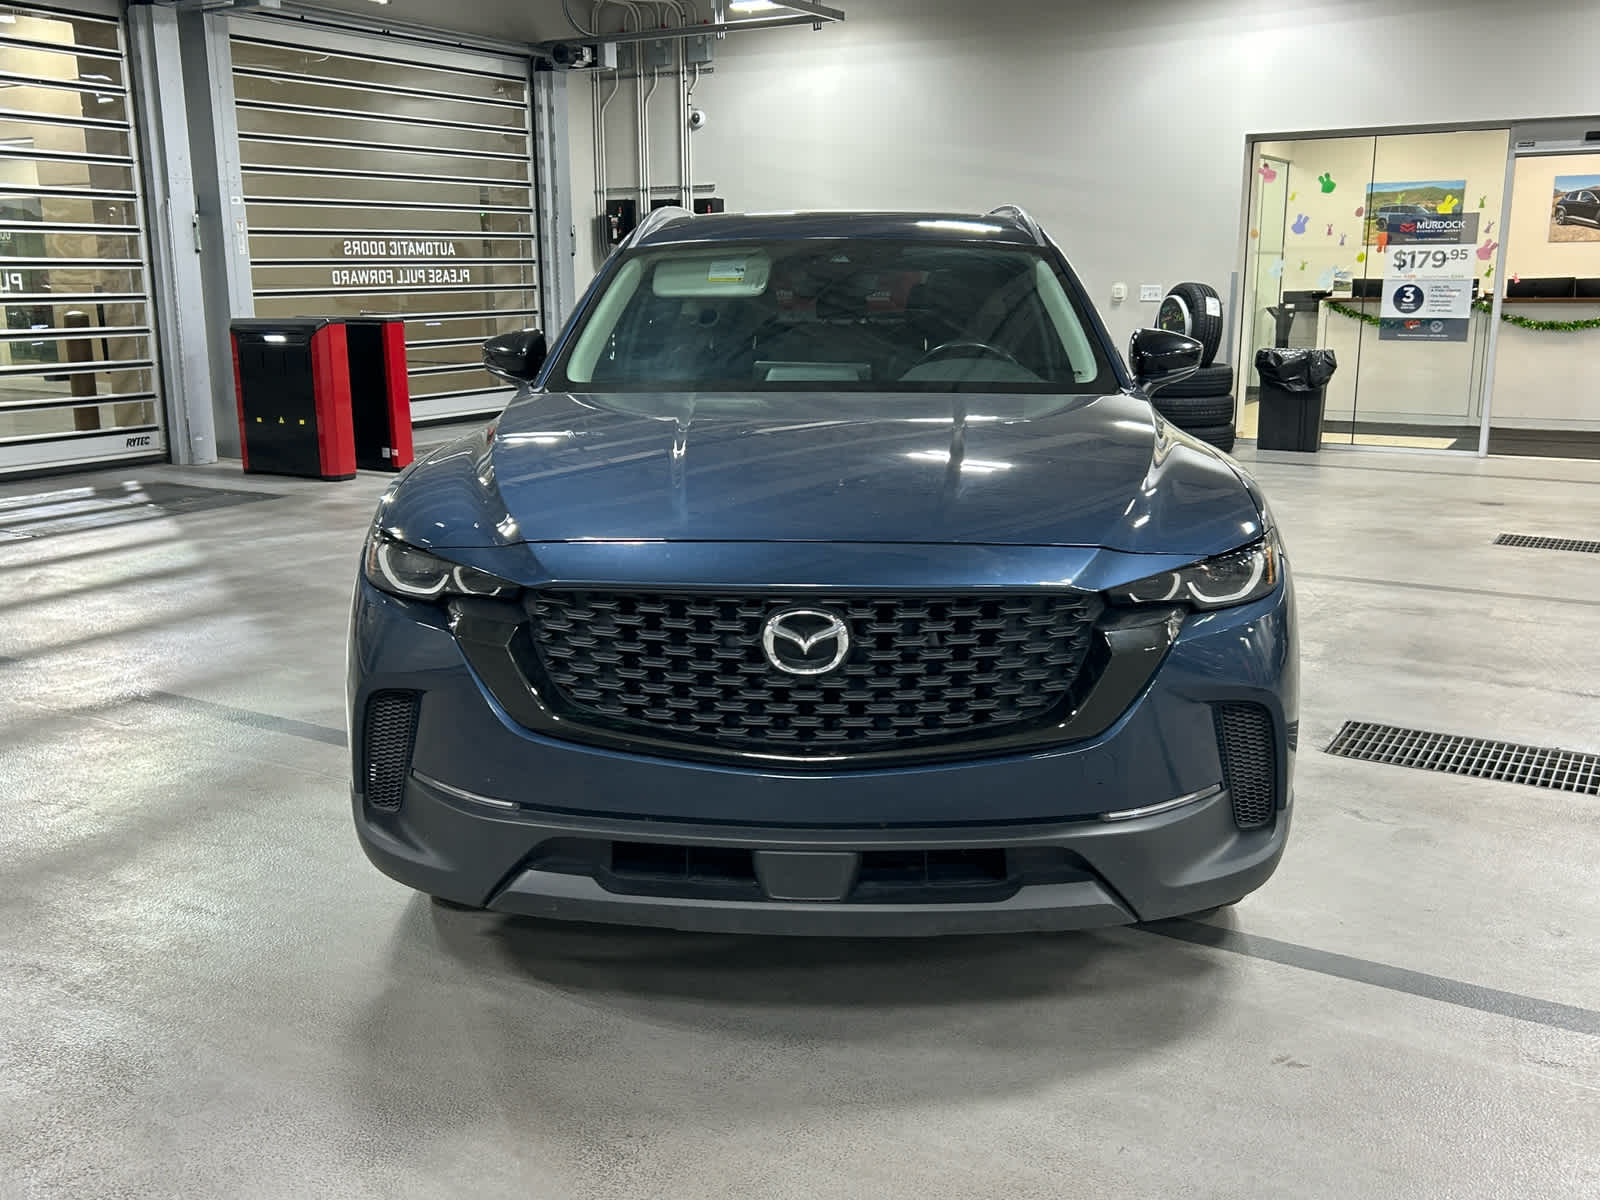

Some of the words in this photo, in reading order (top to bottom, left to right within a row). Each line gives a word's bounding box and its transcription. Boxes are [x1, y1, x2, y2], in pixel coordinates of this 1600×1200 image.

[1416, 220, 1465, 230] MURDOCK
[1402, 287, 1415, 303] 3
[126, 435, 151, 448] RYTEC
